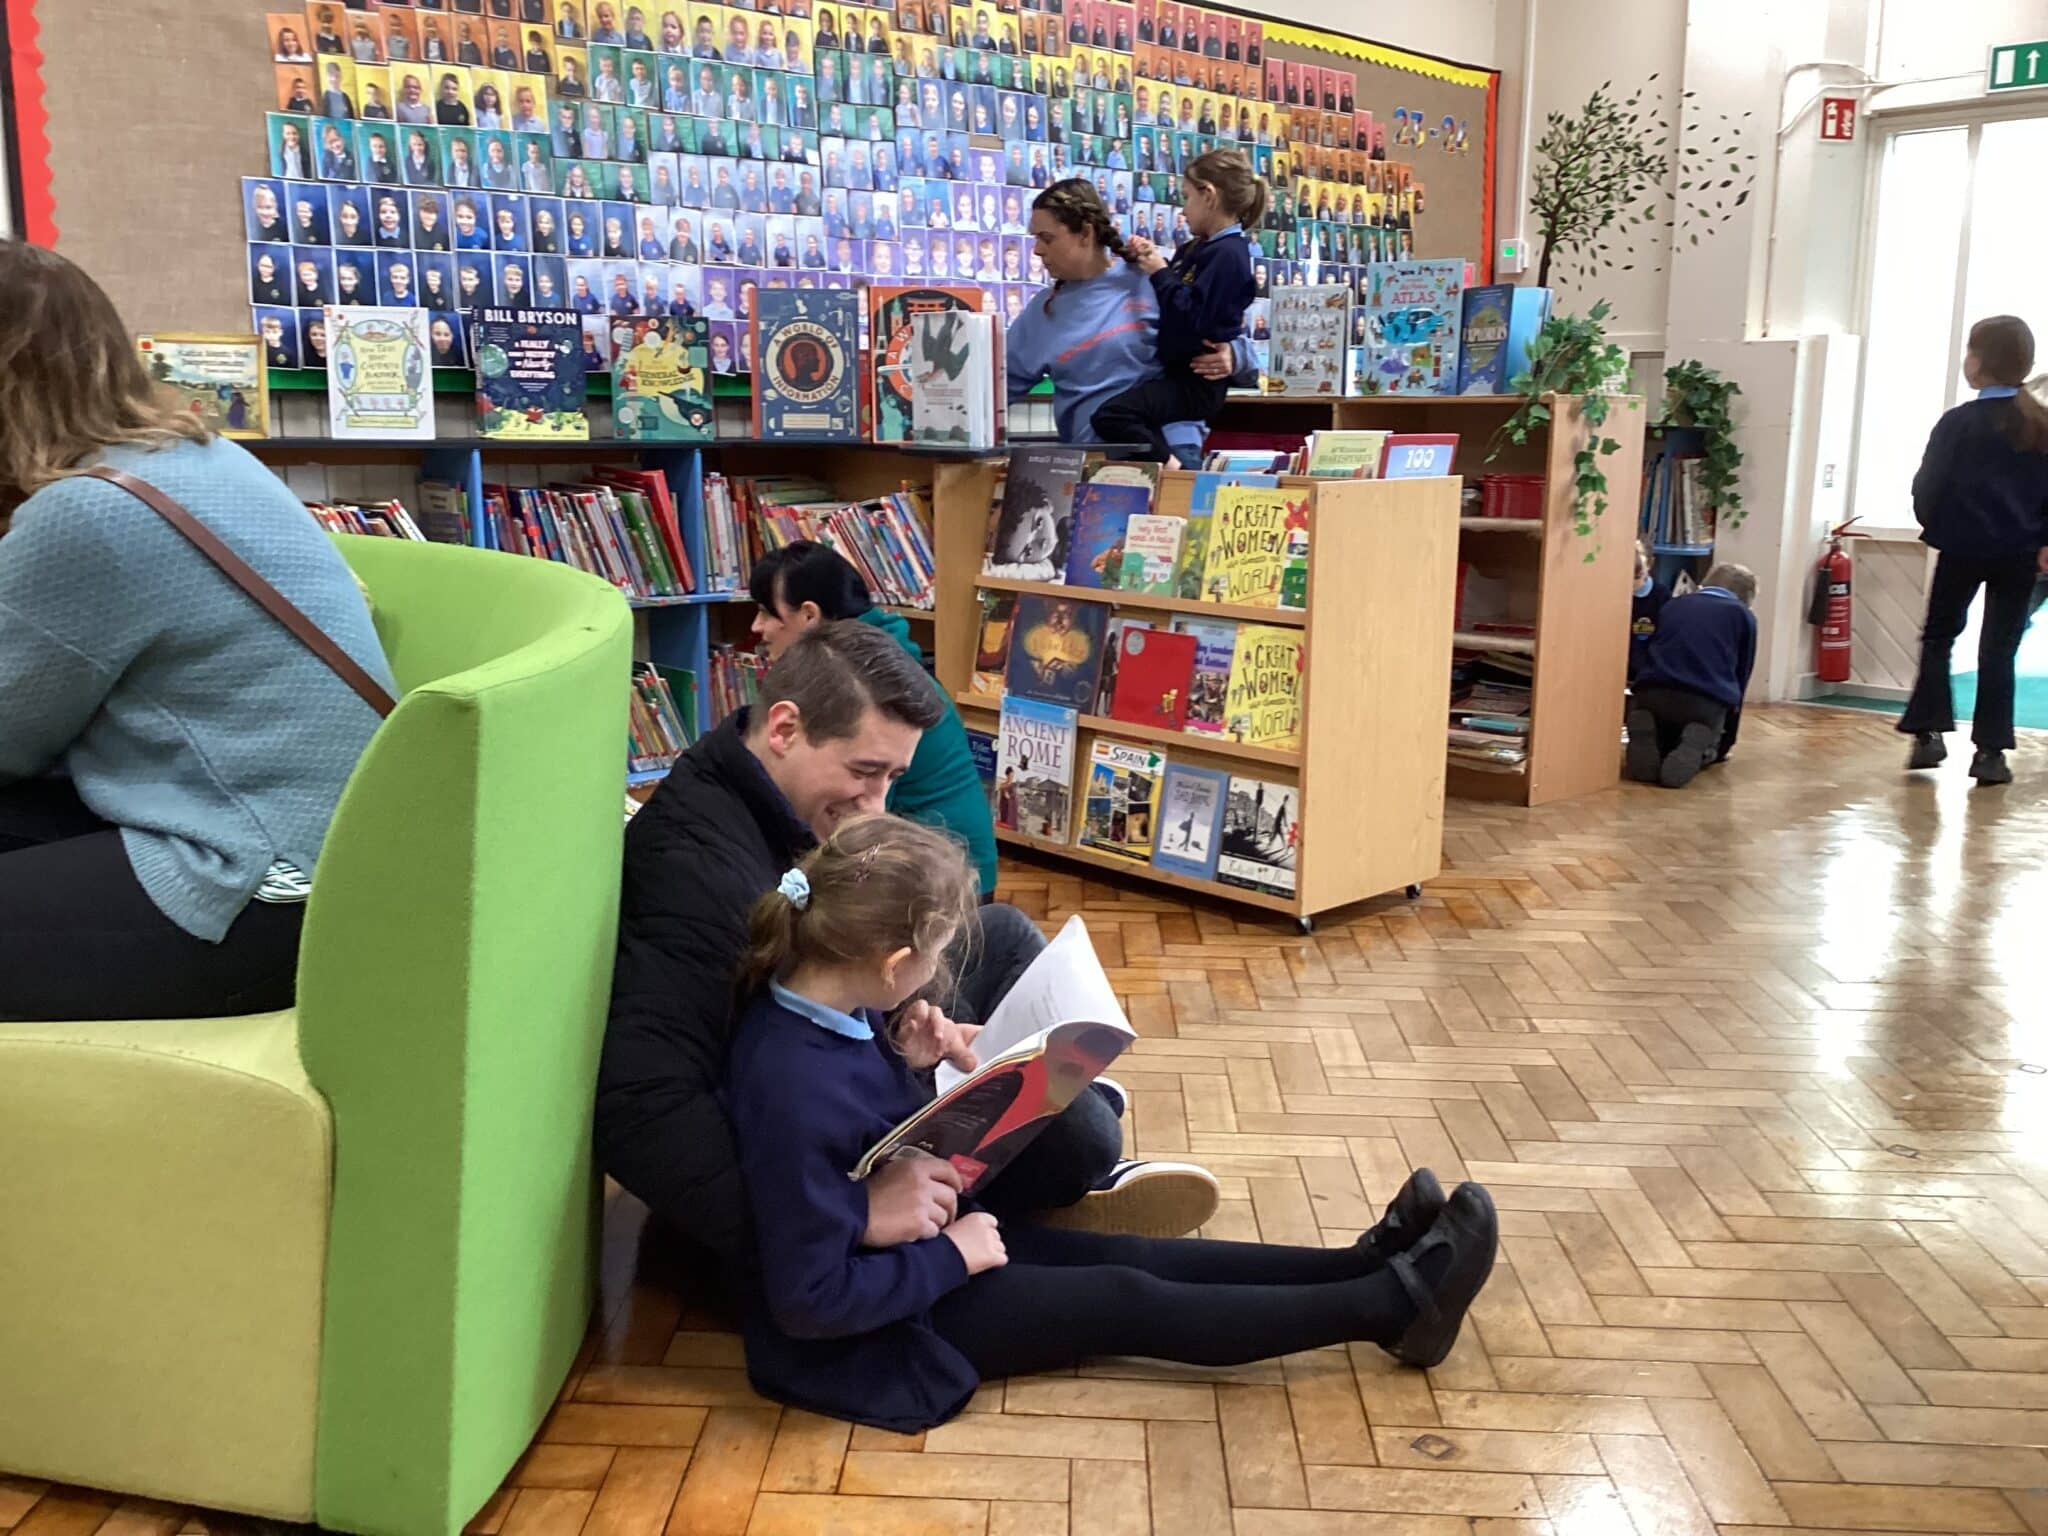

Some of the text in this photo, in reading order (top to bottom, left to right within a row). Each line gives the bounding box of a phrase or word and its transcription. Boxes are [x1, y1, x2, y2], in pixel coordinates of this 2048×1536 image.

[1393, 107, 1469, 153] 23-24
[1391, 291, 1436, 304] ATLAS
[484, 309, 577, 325] BILL BRYSON
[781, 322, 823, 337] WORLD
[825, 335, 838, 349] OF
[639, 369, 678, 378] GENERAL
[641, 373, 696, 387] KNOWLEDGE
[773, 374, 840, 400] INFORMATION
[1404, 449, 1435, 469] 100
[1233, 503, 1283, 529] GREAT
[1220, 528, 1288, 560] WOMEN
[1228, 564, 1282, 598] WORLD
[1255, 644, 1295, 670] GREAT
[1242, 667, 1300, 700] WOMEN
[1003, 714, 1069, 744] ANCIENT
[1250, 707, 1300, 739] WORLD
[1007, 734, 1062, 769] ROME
[1110, 746, 1147, 769] SPAIN
